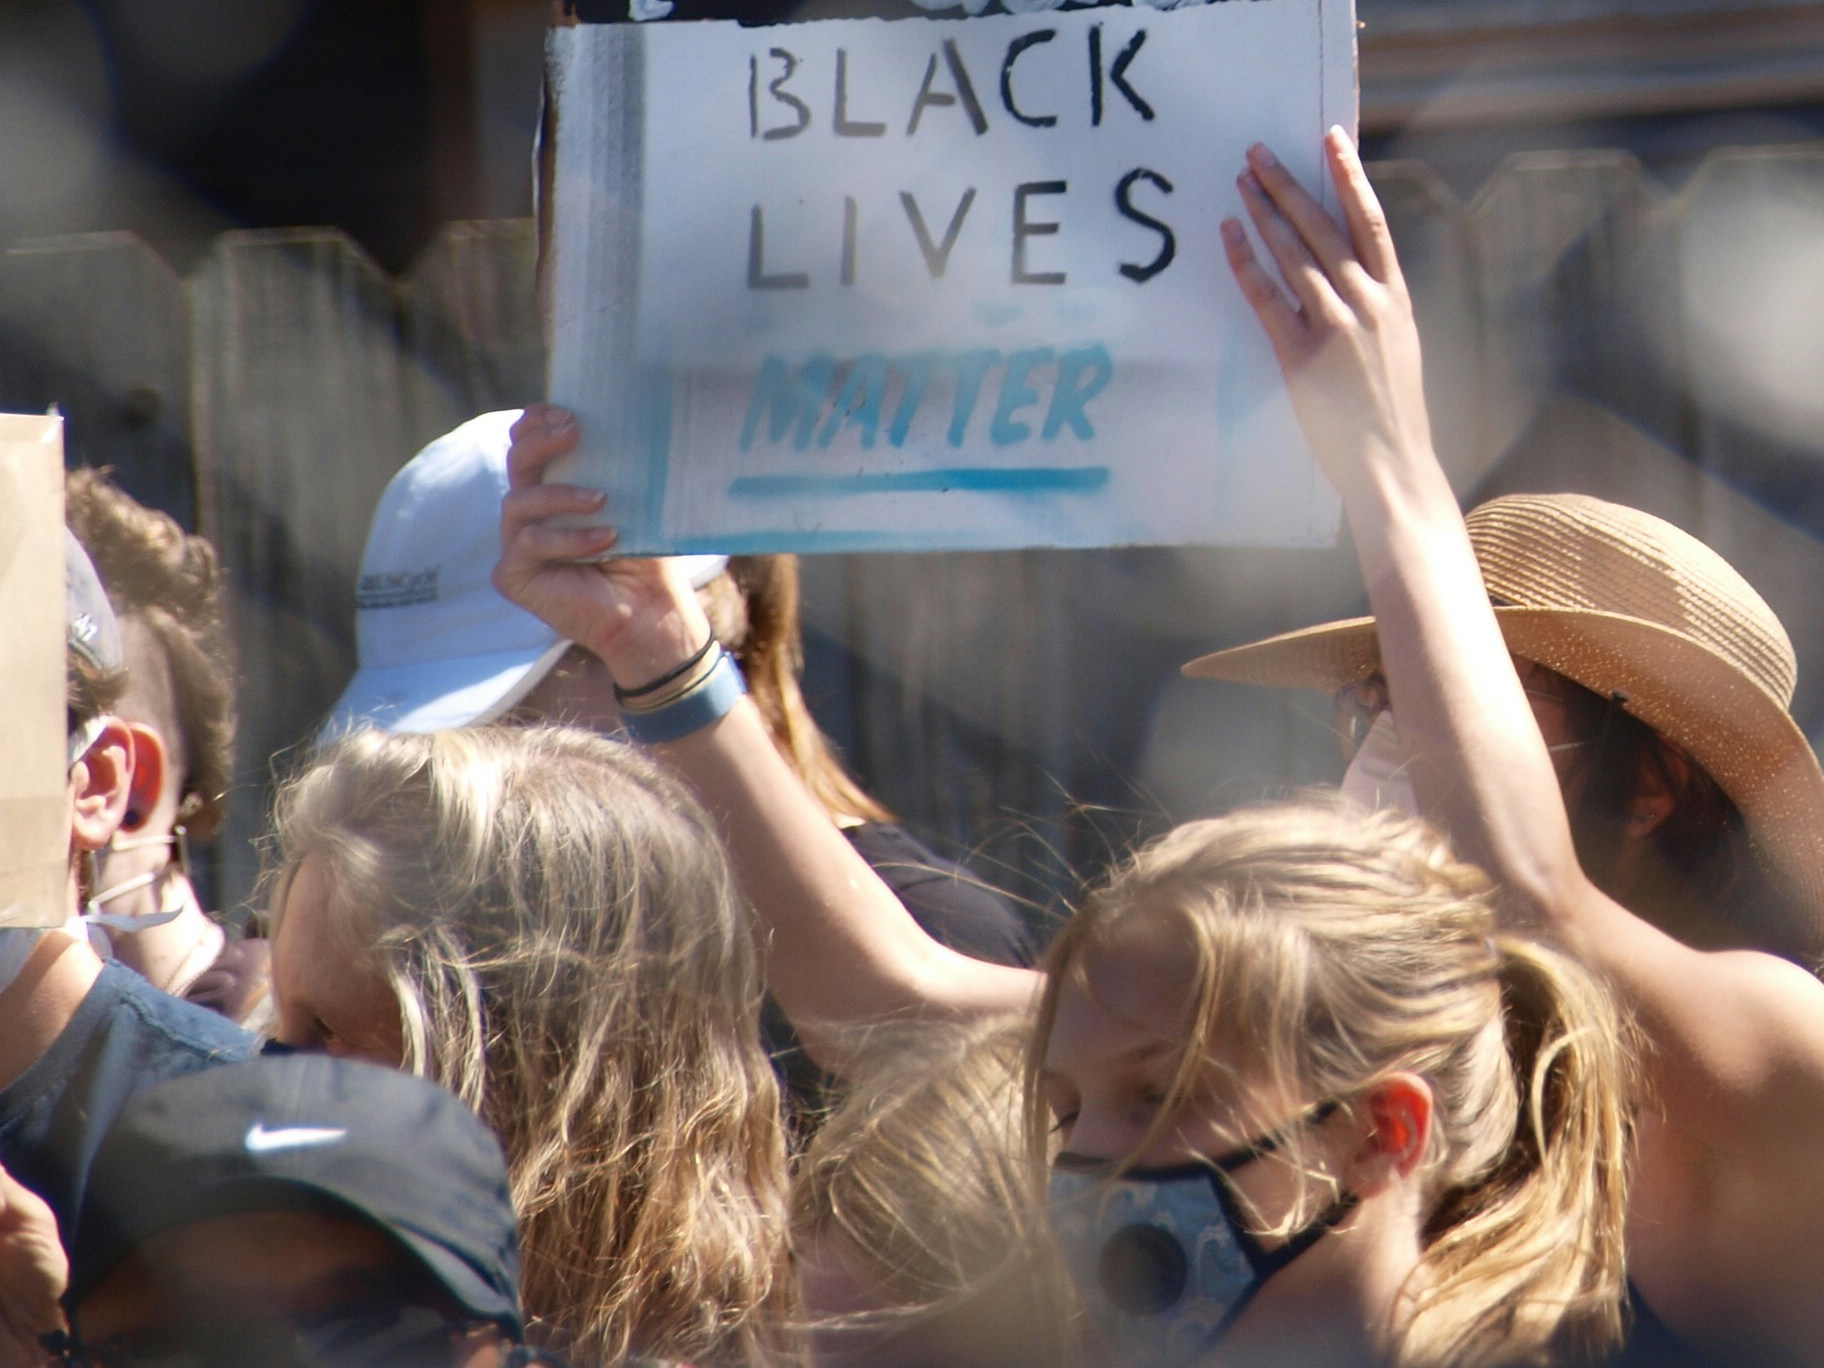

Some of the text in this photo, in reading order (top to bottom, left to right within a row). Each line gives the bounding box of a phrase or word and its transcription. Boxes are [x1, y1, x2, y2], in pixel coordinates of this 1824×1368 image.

[747, 24, 1156, 142] BLACK
[746, 167, 1177, 291] LIVES
[737, 341, 1114, 453] MATTER
